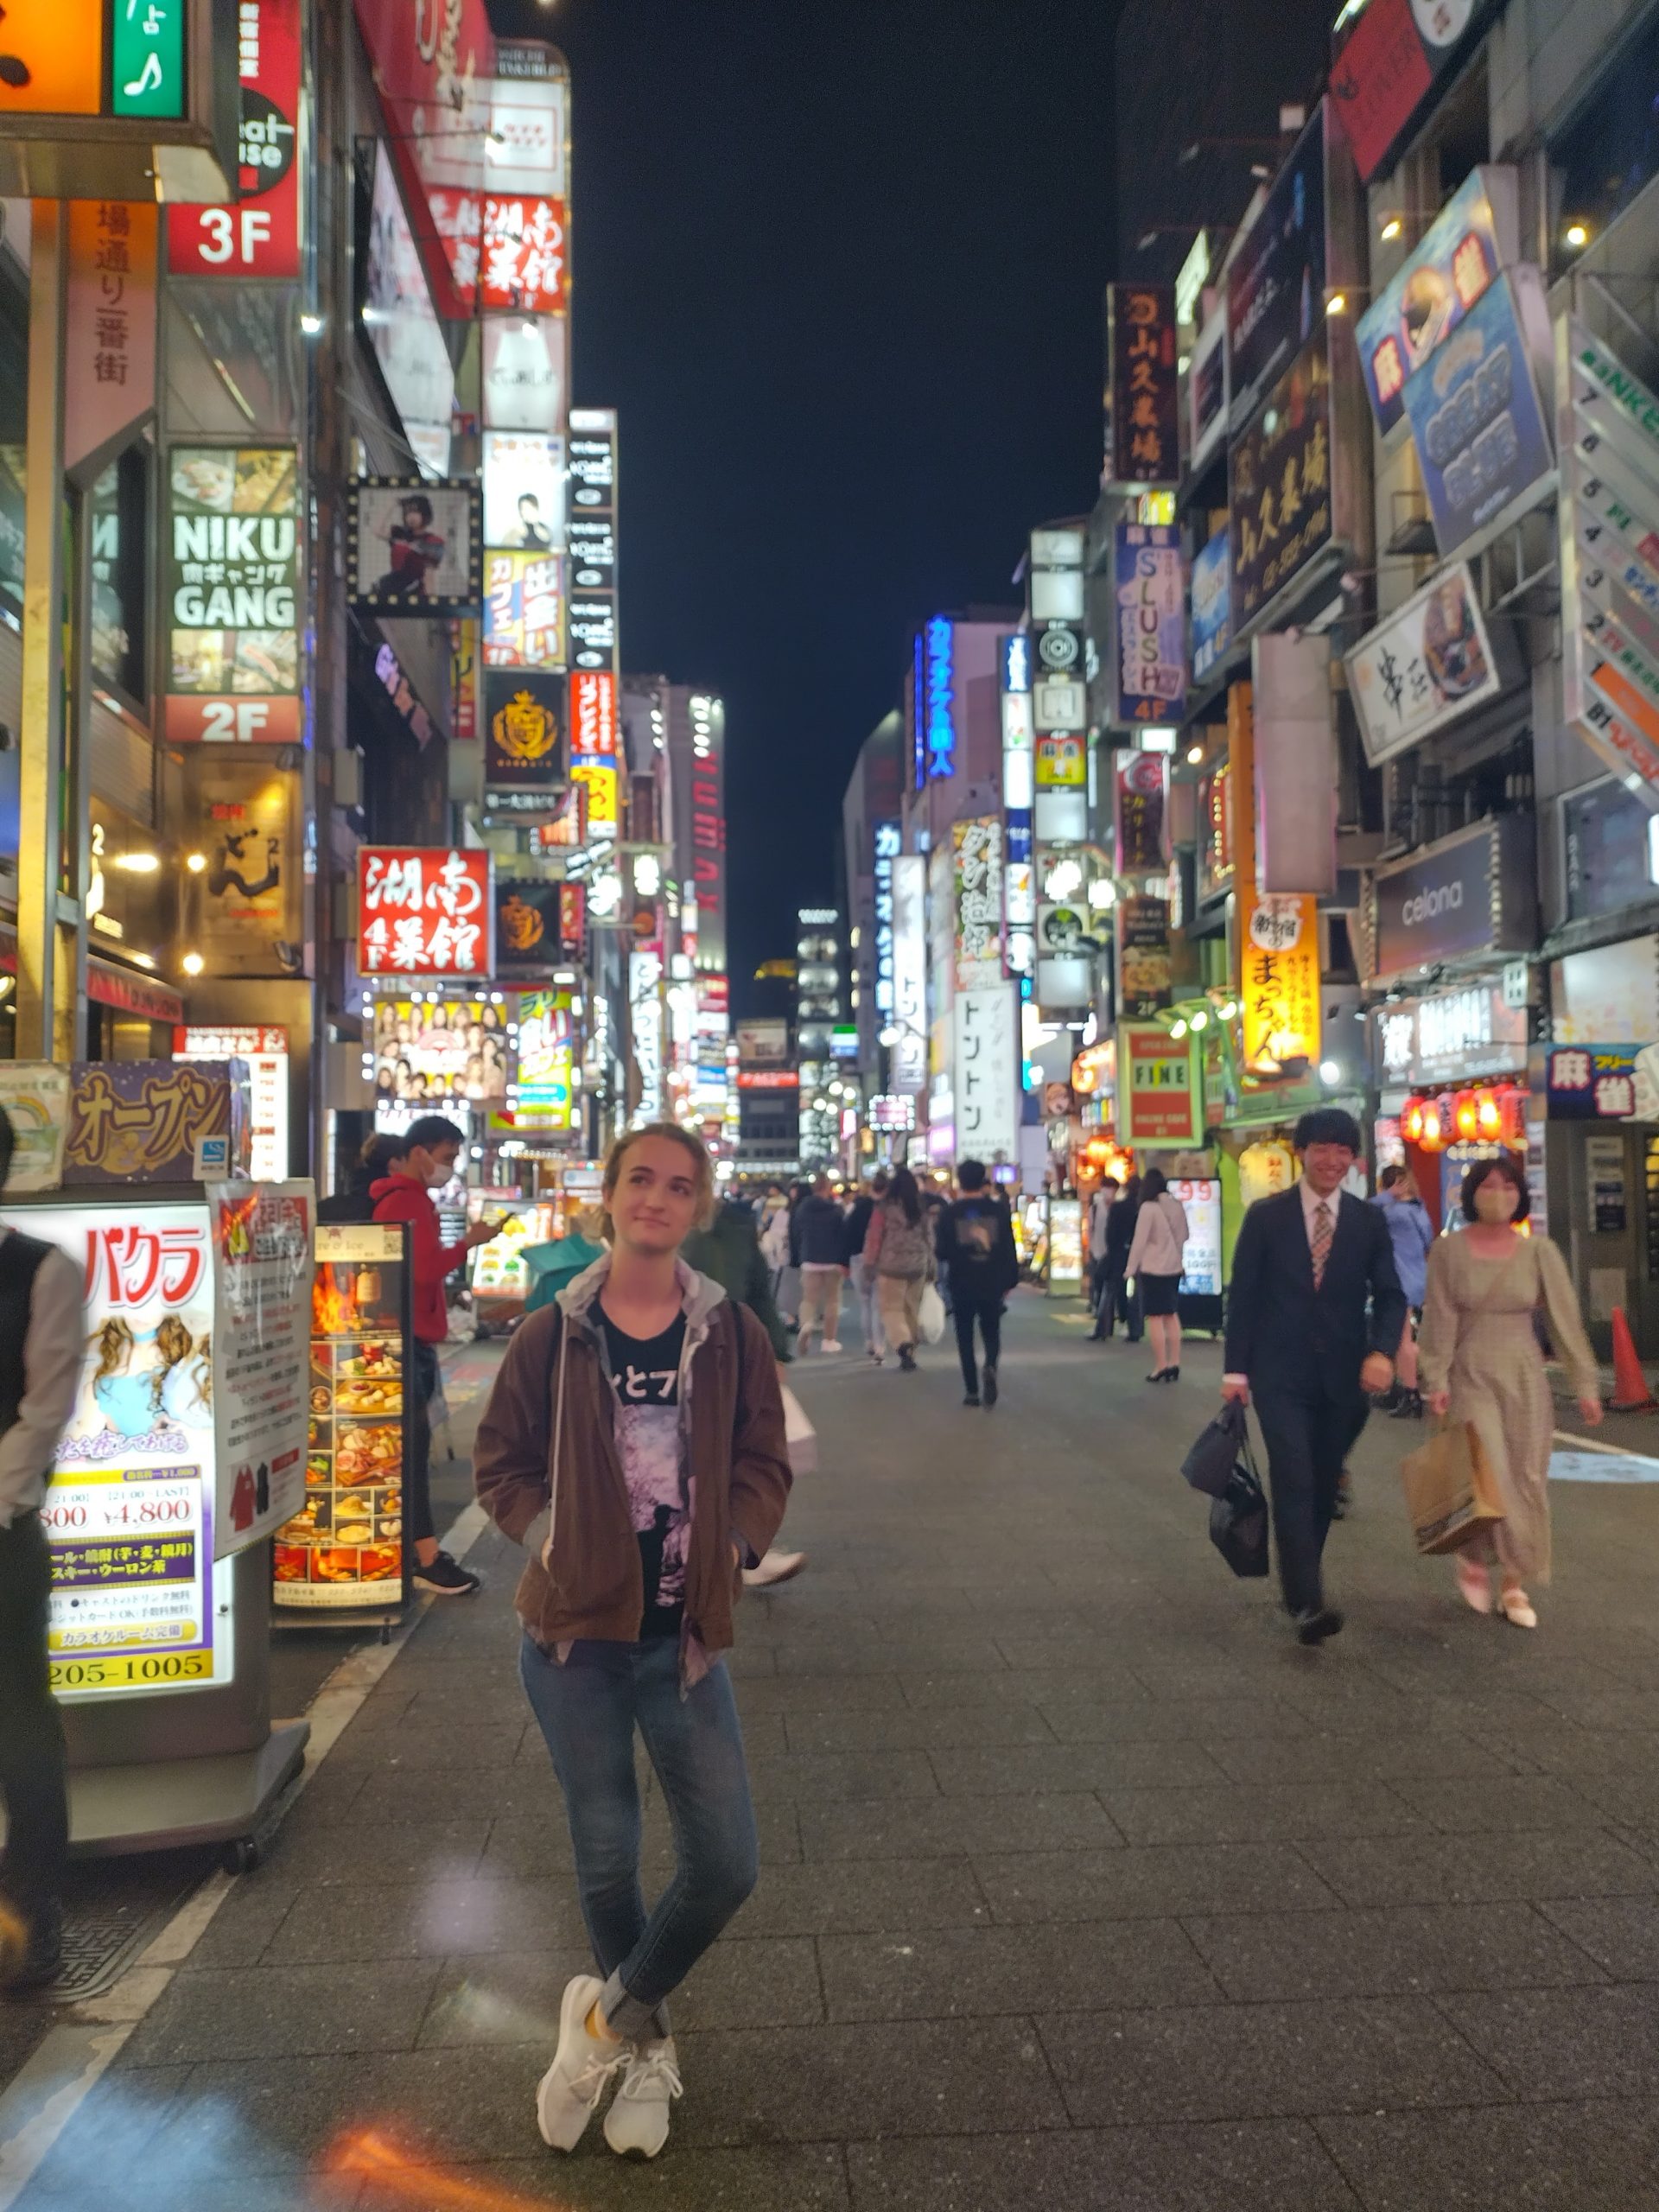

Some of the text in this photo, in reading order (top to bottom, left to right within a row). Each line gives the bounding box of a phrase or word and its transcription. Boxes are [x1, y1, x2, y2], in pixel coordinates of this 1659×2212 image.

[240, 113, 295, 143] at
[199, 209, 270, 264] 3F
[174, 516, 295, 561] NIKU
[175, 586, 295, 627] GANG
[1141, 553, 1160, 691] SLUSH
[201, 702, 269, 741] 2F
[365, 851, 482, 916] 湖南
[1402, 879, 1464, 926] celona
[389, 916, 481, 971] 菜館
[1253, 953, 1285, 1062] まっちゃん
[1135, 1065, 1185, 1085] FINE
[1593, 1054, 1634, 1071] フリー
[73, 1071, 230, 1160] オープン
[105, 1499, 190, 1525] ¥4,800
[49, 1655, 203, 1685] 205-1005
